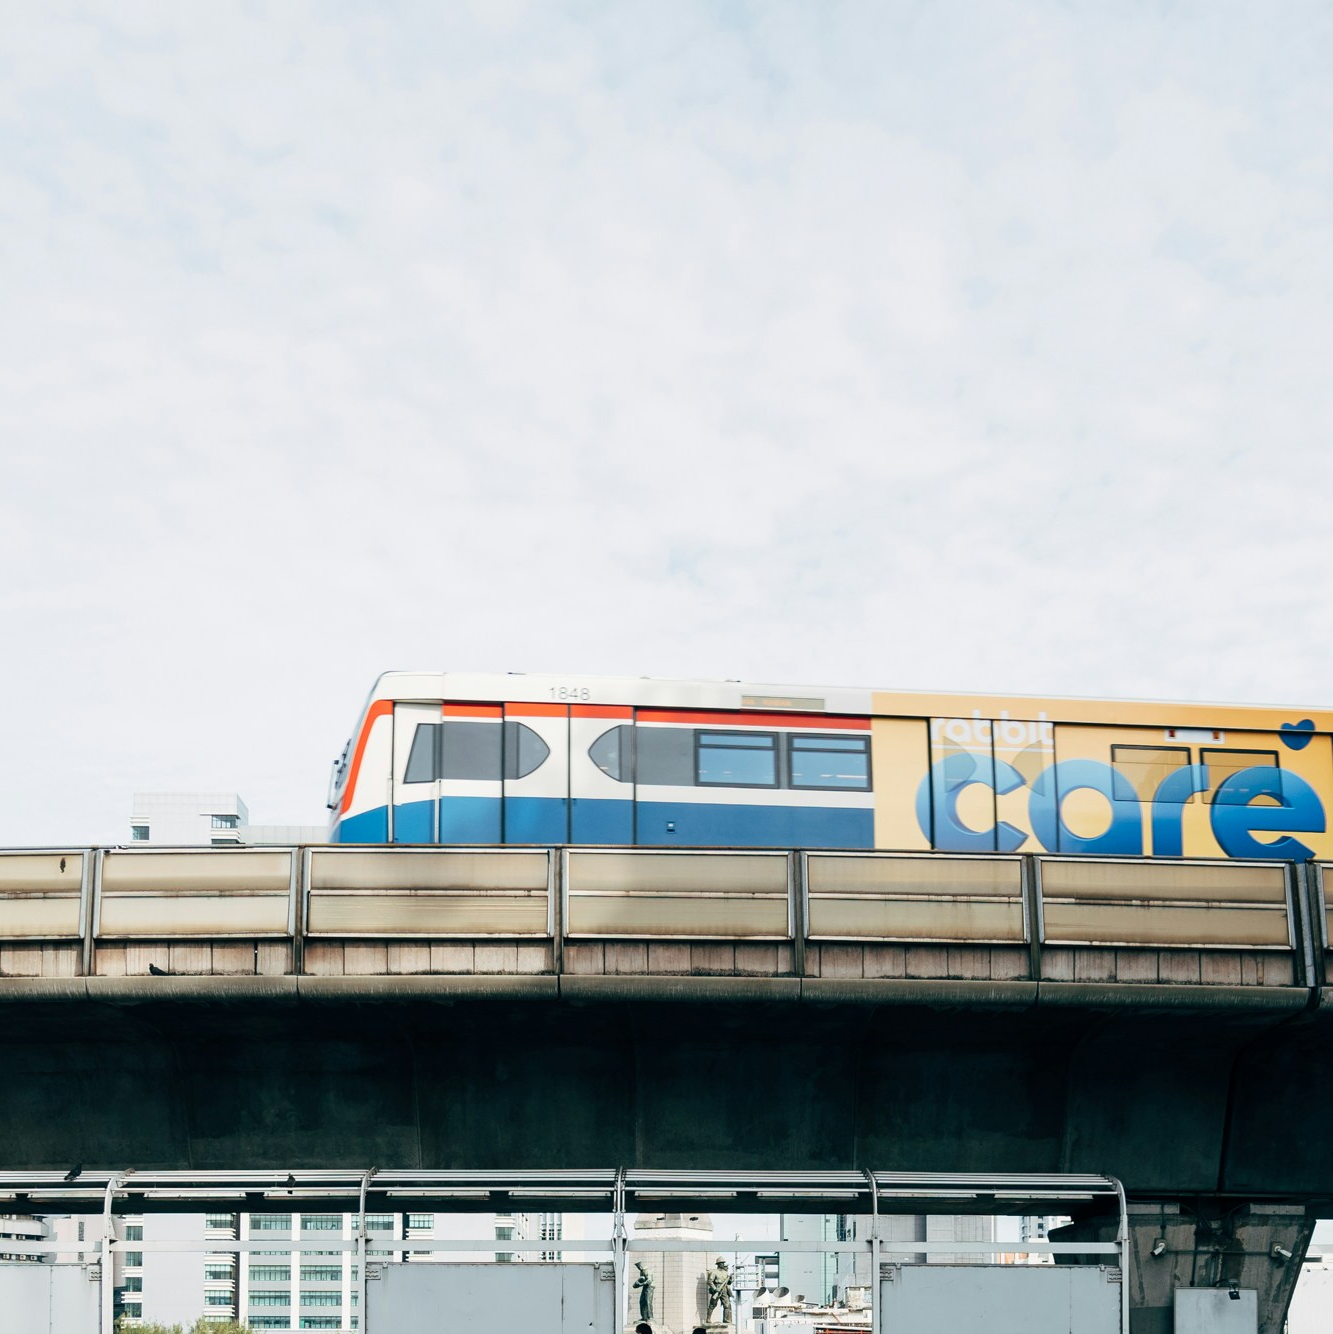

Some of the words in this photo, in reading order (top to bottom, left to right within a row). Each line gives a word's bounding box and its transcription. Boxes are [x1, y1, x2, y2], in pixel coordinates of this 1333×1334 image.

[549, 686, 591, 701] 1848
[930, 710, 1055, 746] rabbit
[916, 753, 1326, 860] care
